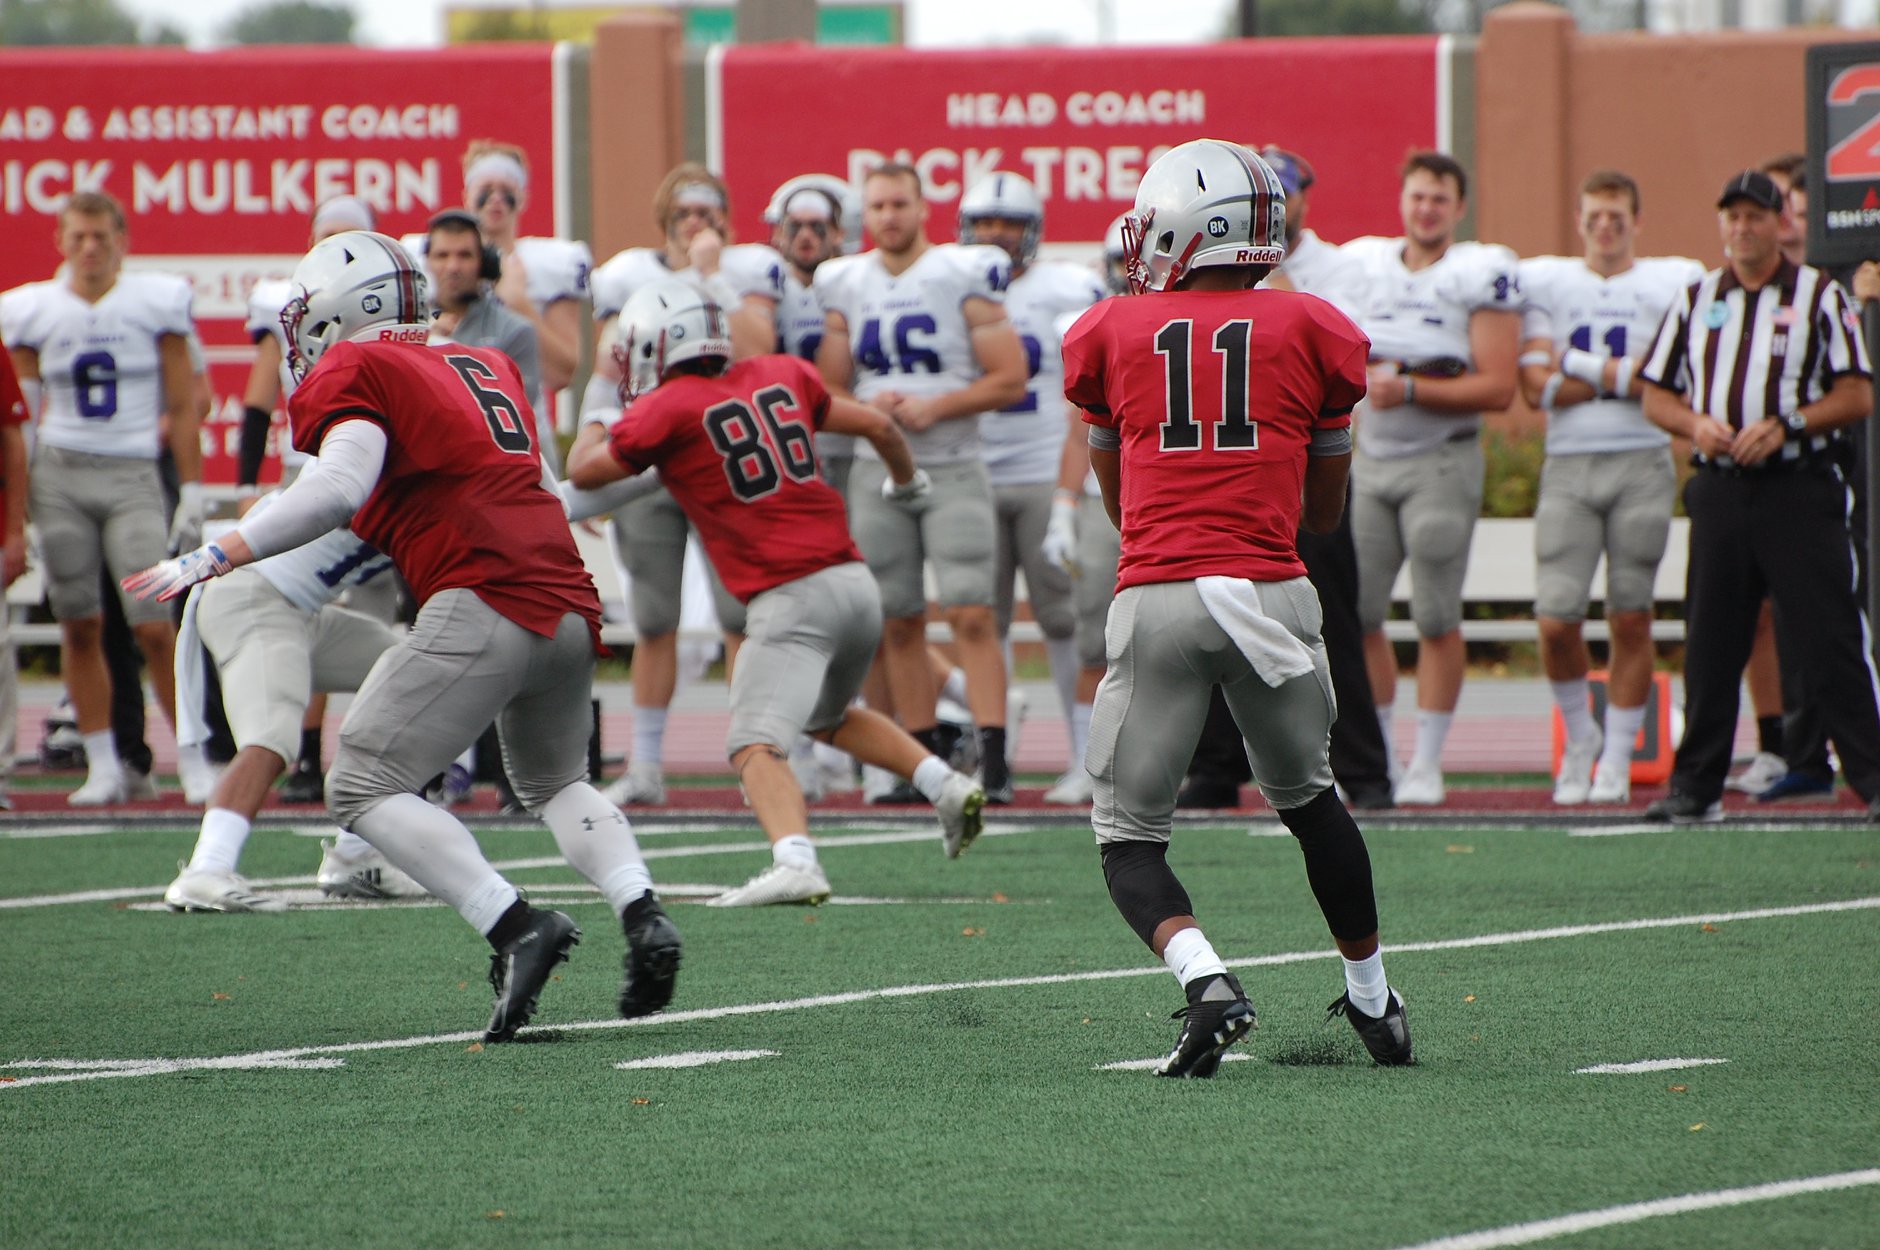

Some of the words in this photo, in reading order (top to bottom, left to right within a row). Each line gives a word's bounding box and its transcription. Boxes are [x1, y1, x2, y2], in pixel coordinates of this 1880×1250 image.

[62, 105, 93, 141] &
[102, 104, 313, 141] ASSISTANT
[321, 104, 459, 139] COACH
[946, 93, 1057, 128] HEAD
[1066, 89, 1206, 126] COACH
[0, 158, 112, 215] ICK
[132, 156, 440, 215] MULKERN
[1210, 220, 1227, 234] BK
[1236, 249, 1282, 263] Riddell
[856, 312, 941, 376] 46
[71, 350, 117, 420] 6
[443, 354, 532, 455] 6
[1153, 318, 1259, 452] 11
[702, 382, 817, 504] 86
